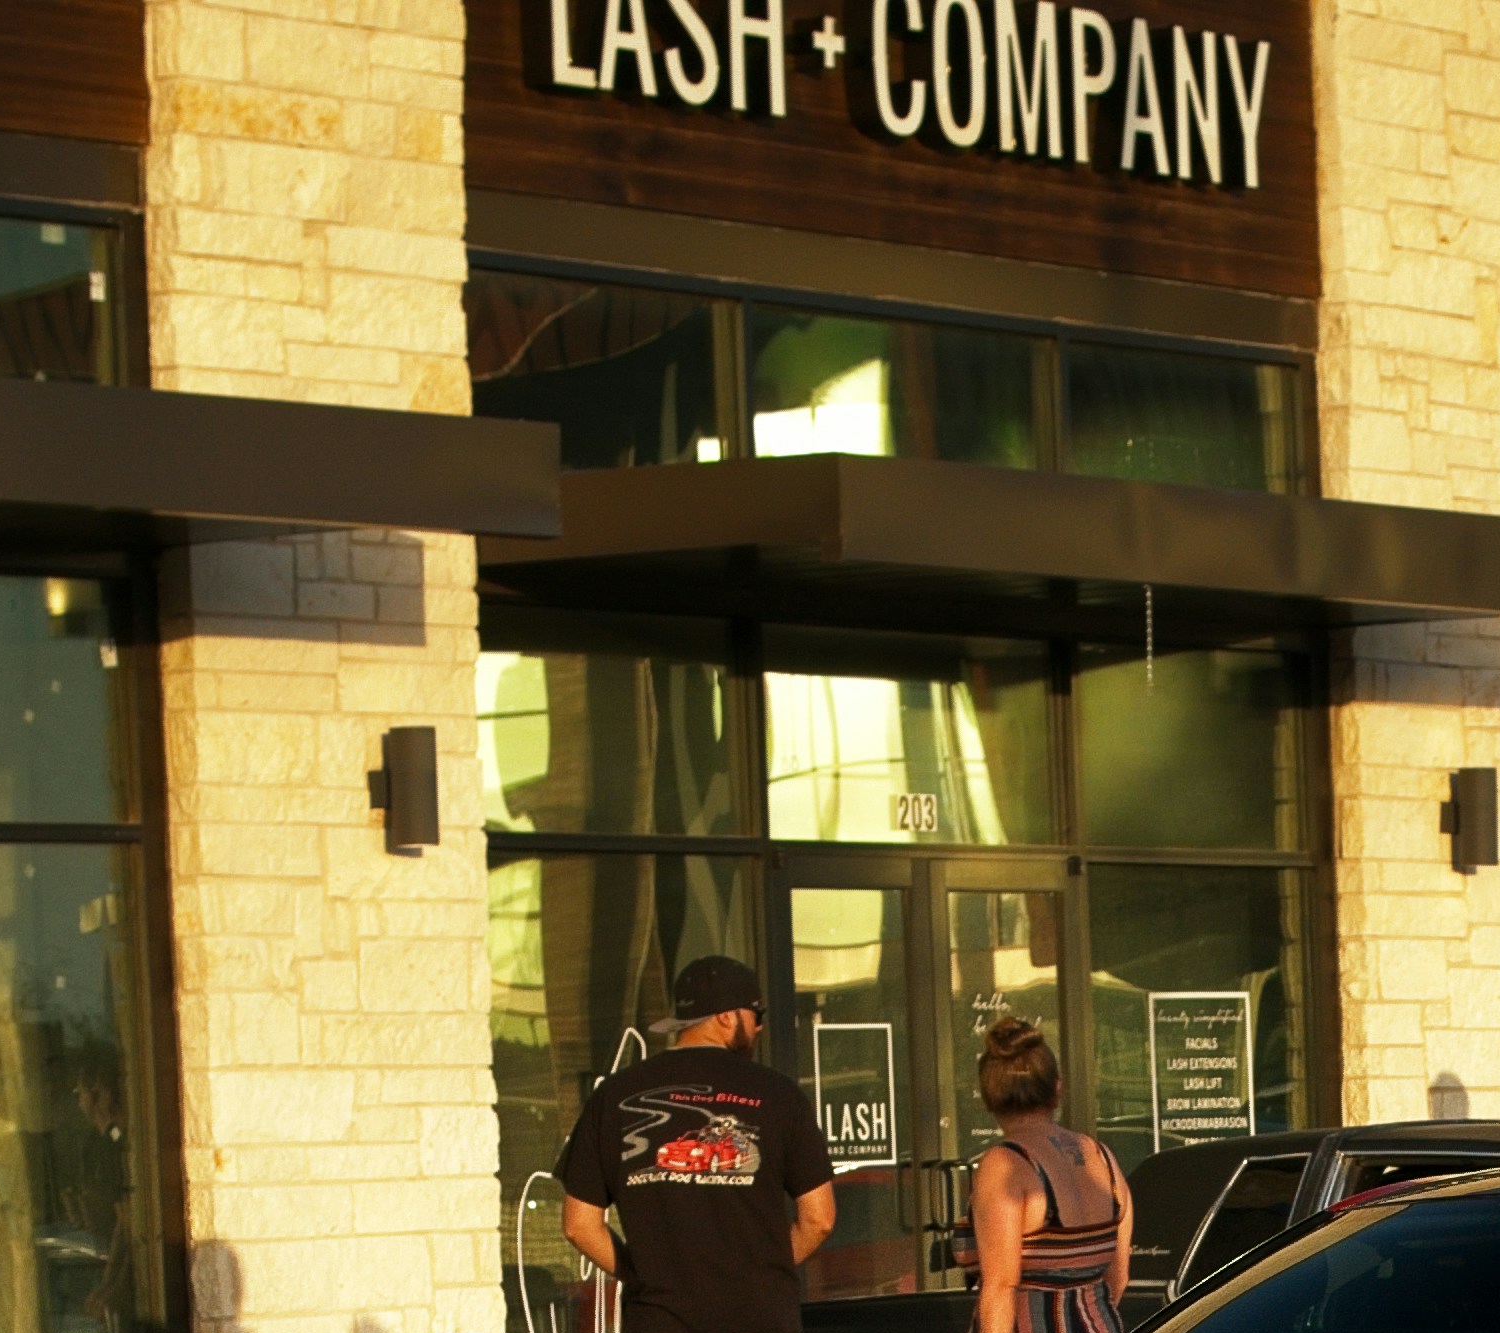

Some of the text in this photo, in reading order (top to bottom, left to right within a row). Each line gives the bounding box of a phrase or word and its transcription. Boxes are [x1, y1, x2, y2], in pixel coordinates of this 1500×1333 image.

[550, 0, 787, 117] LASH
[871, 0, 1270, 188] COMPANY
[899, 795, 935, 830] 203
[1185, 1037, 1218, 1050] FACIALS
[1166, 1057, 1238, 1070] LASH EXTENSIONS
[1183, 1077, 1223, 1090] LASH LIFT
[716, 1092, 762, 1108] Bites!
[1166, 1097, 1241, 1110] BROW LAMINATION
[826, 1102, 887, 1141] LASH
[848, 1145, 887, 1154] COMPANY
